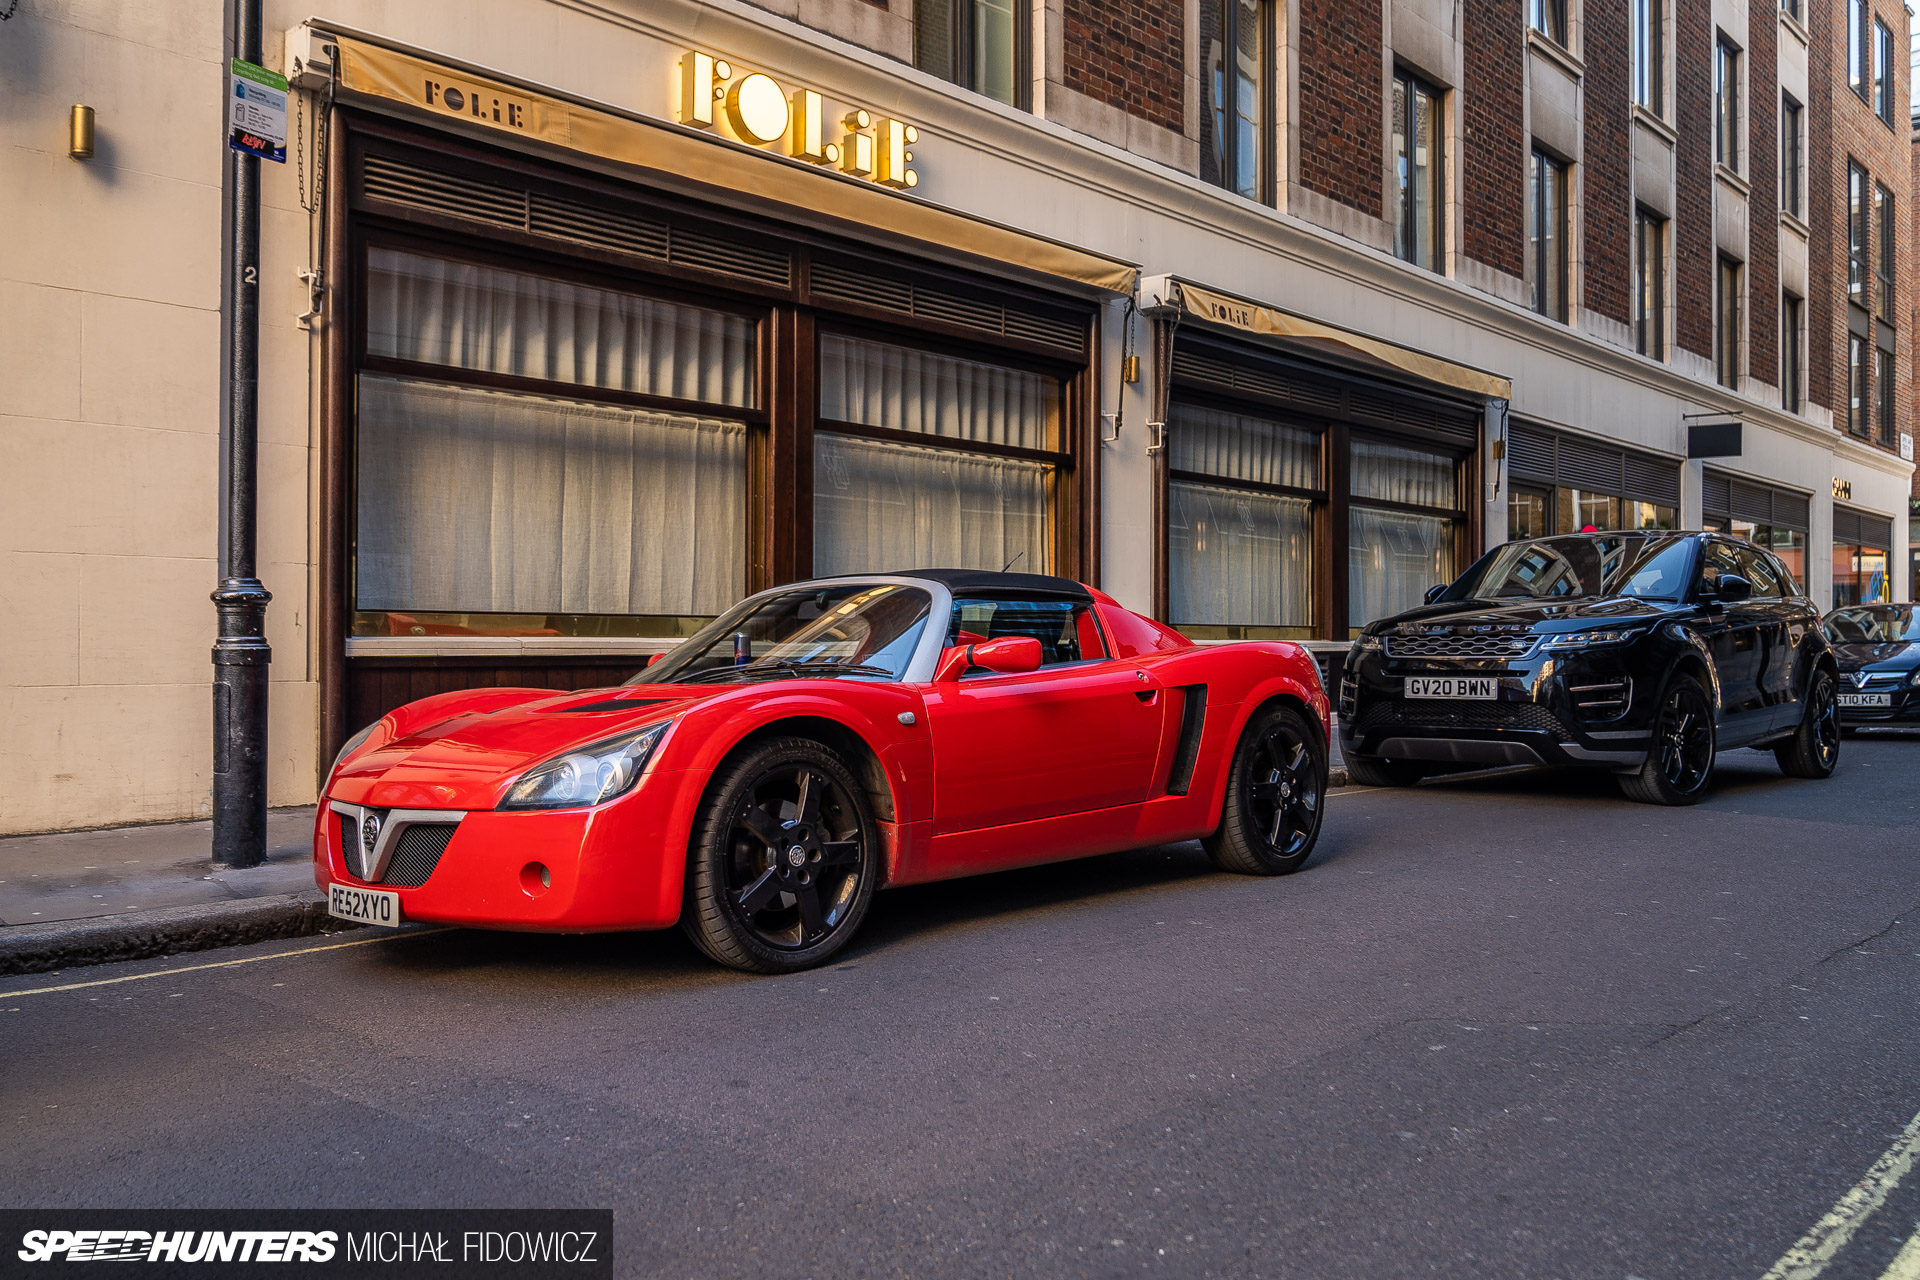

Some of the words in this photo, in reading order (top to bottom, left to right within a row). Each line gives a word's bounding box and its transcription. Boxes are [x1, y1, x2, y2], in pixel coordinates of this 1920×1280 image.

[244, 266, 257, 284] 2
[1411, 680, 1452, 695] GV20
[1457, 680, 1490, 696] BWN
[1861, 695, 1883, 705] KFA
